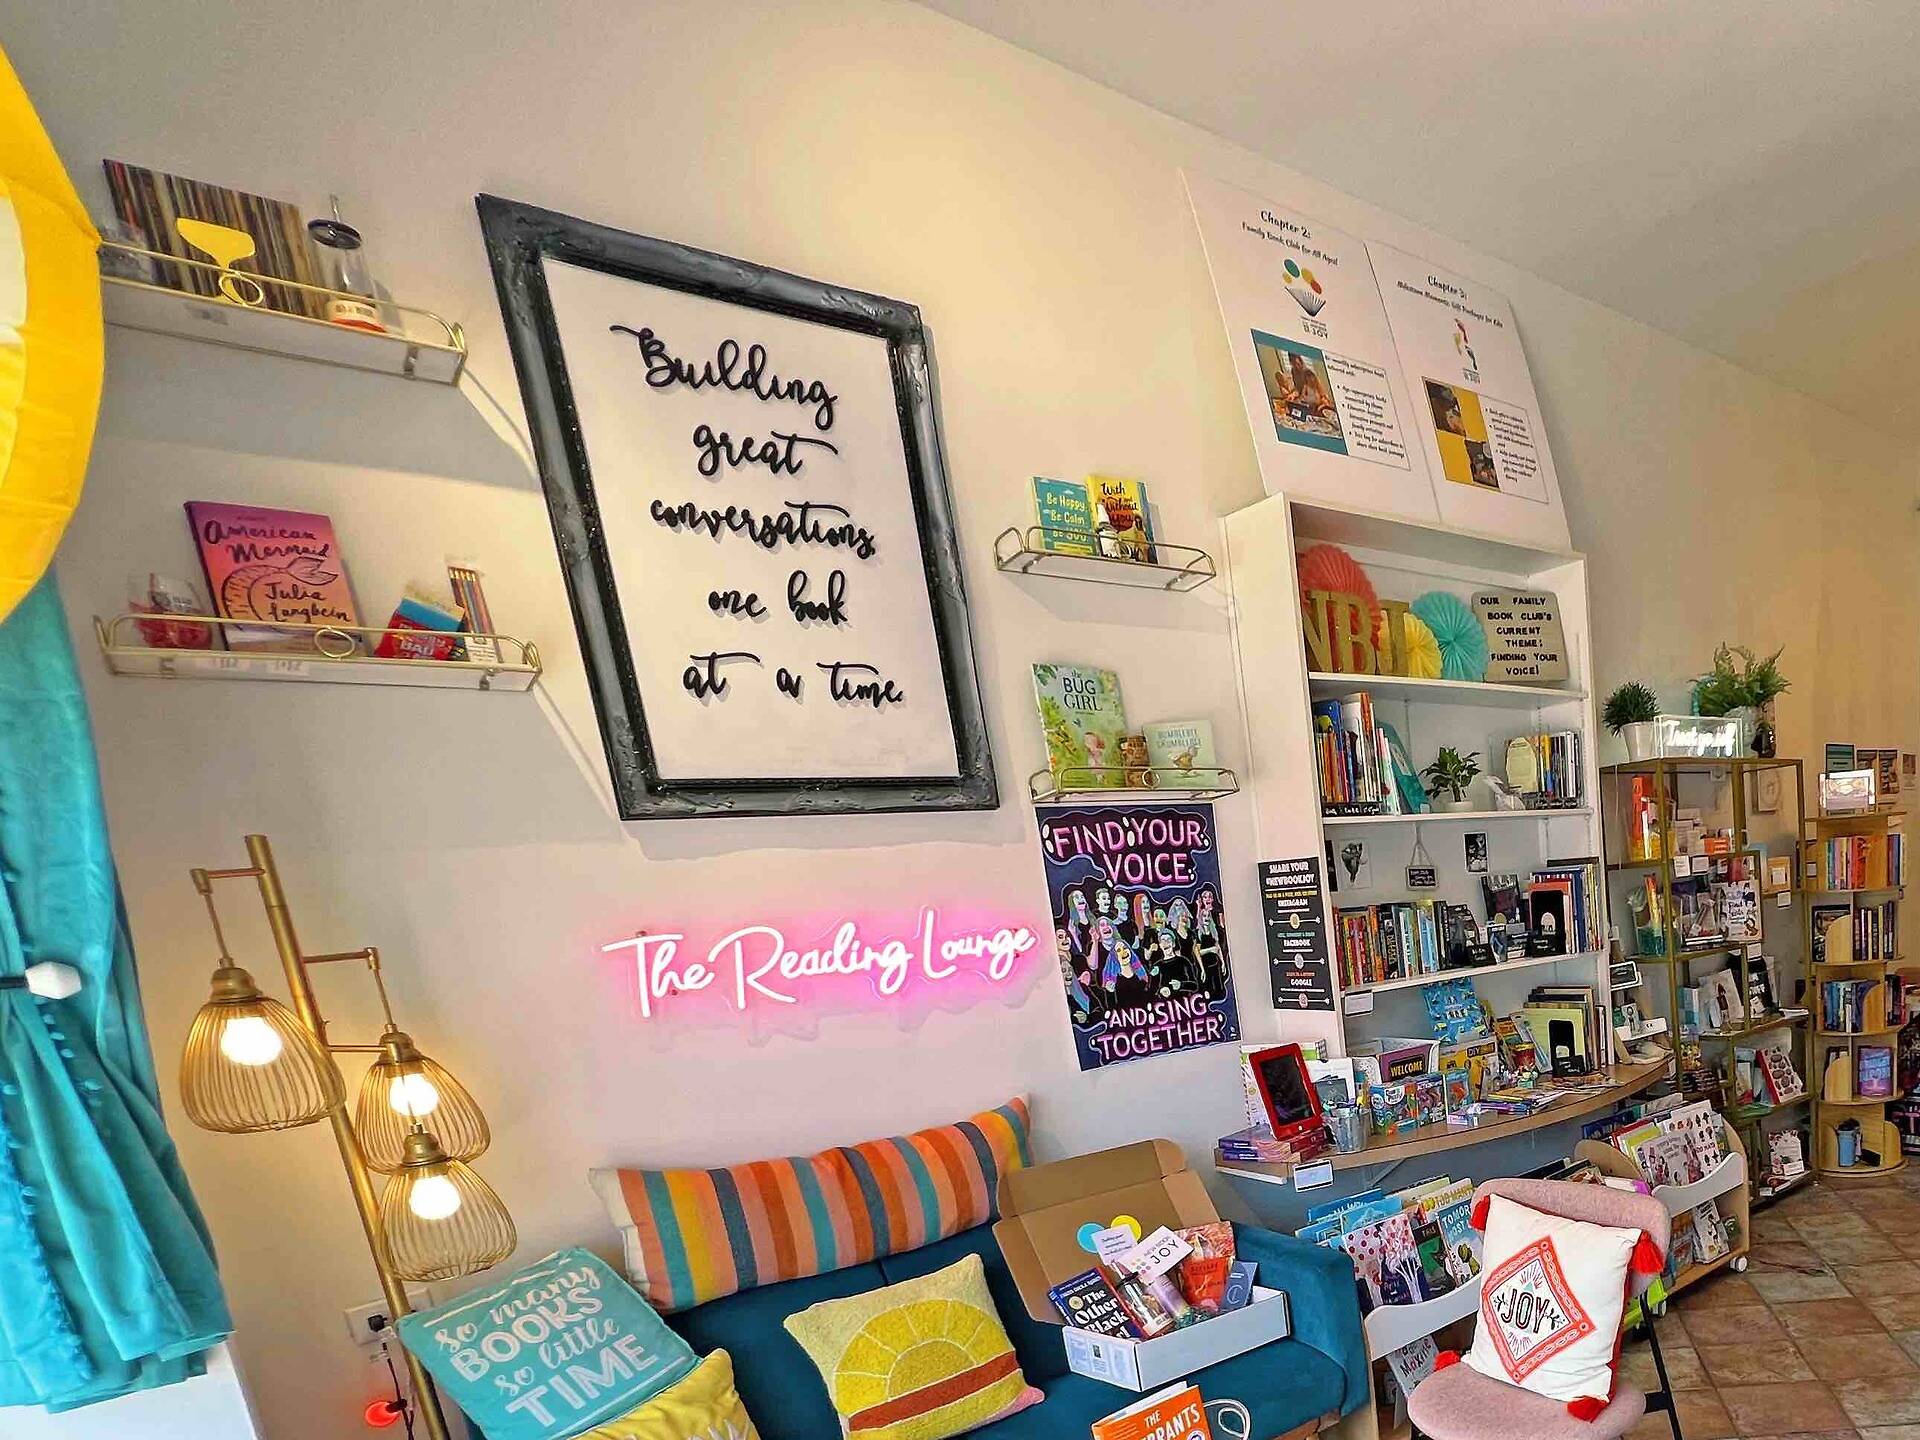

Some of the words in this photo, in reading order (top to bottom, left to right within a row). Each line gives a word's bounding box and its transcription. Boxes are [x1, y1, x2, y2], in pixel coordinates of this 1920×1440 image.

[1261, 210, 1299, 233] Chapter
[1427, 275, 1458, 293] Chapter
[610, 325, 838, 431] Building
[693, 424, 838, 476] great
[1101, 481, 1125, 496] With
[205, 520, 317, 544] American
[650, 499, 876, 560] conversations
[228, 543, 330, 563] Mermaid
[265, 581, 327, 601] Julia
[708, 589, 767, 617] one
[787, 570, 848, 625] book
[1480, 597, 1499, 605] OUR
[1512, 597, 1546, 605] FAMILY
[268, 603, 351, 623] Langbein
[1488, 612, 1513, 620] BOOK
[1496, 626, 1541, 635] CURRENT
[1505, 639, 1543, 648] THEME:
[1491, 653, 1526, 661] FINDING
[1533, 653, 1558, 662] YOUR
[683, 651, 761, 699] at
[776, 667, 801, 698] a
[816, 661, 903, 708] time
[1506, 664, 1539, 675] VOICE!
[1063, 677, 1096, 694] BUG
[1063, 693, 1103, 711] GIRL
[1053, 821, 1125, 859] FIND
[1131, 816, 1203, 847] YOUR
[1103, 852, 1189, 883] VOICE
[1269, 863, 1290, 874] SHARE
[1290, 861, 1309, 872] YOUR
[602, 932, 715, 1018] The
[708, 922, 914, 1010] Reading
[923, 910, 1037, 980] Lounge
[1290, 978, 1312, 987] GOOGLE
[1108, 1009, 1148, 1028] AND
[1155, 996, 1208, 1023] SING
[1097, 1018, 1219, 1061] TOGETHER
[1391, 1060, 1423, 1077] WELCOME
[1150, 1239, 1179, 1265] JOY
[1082, 1289, 1107, 1304] The
[435, 1322, 478, 1353] so
[489, 1266, 600, 1326] many
[1074, 1297, 1118, 1325] Other
[1501, 1288, 1550, 1334] JOY
[450, 1287, 603, 1383] BOOKS
[538, 1318, 620, 1370] little
[494, 1366, 535, 1397] so
[505, 1334, 660, 1428] TIME
[1143, 1409, 1162, 1428] THE
